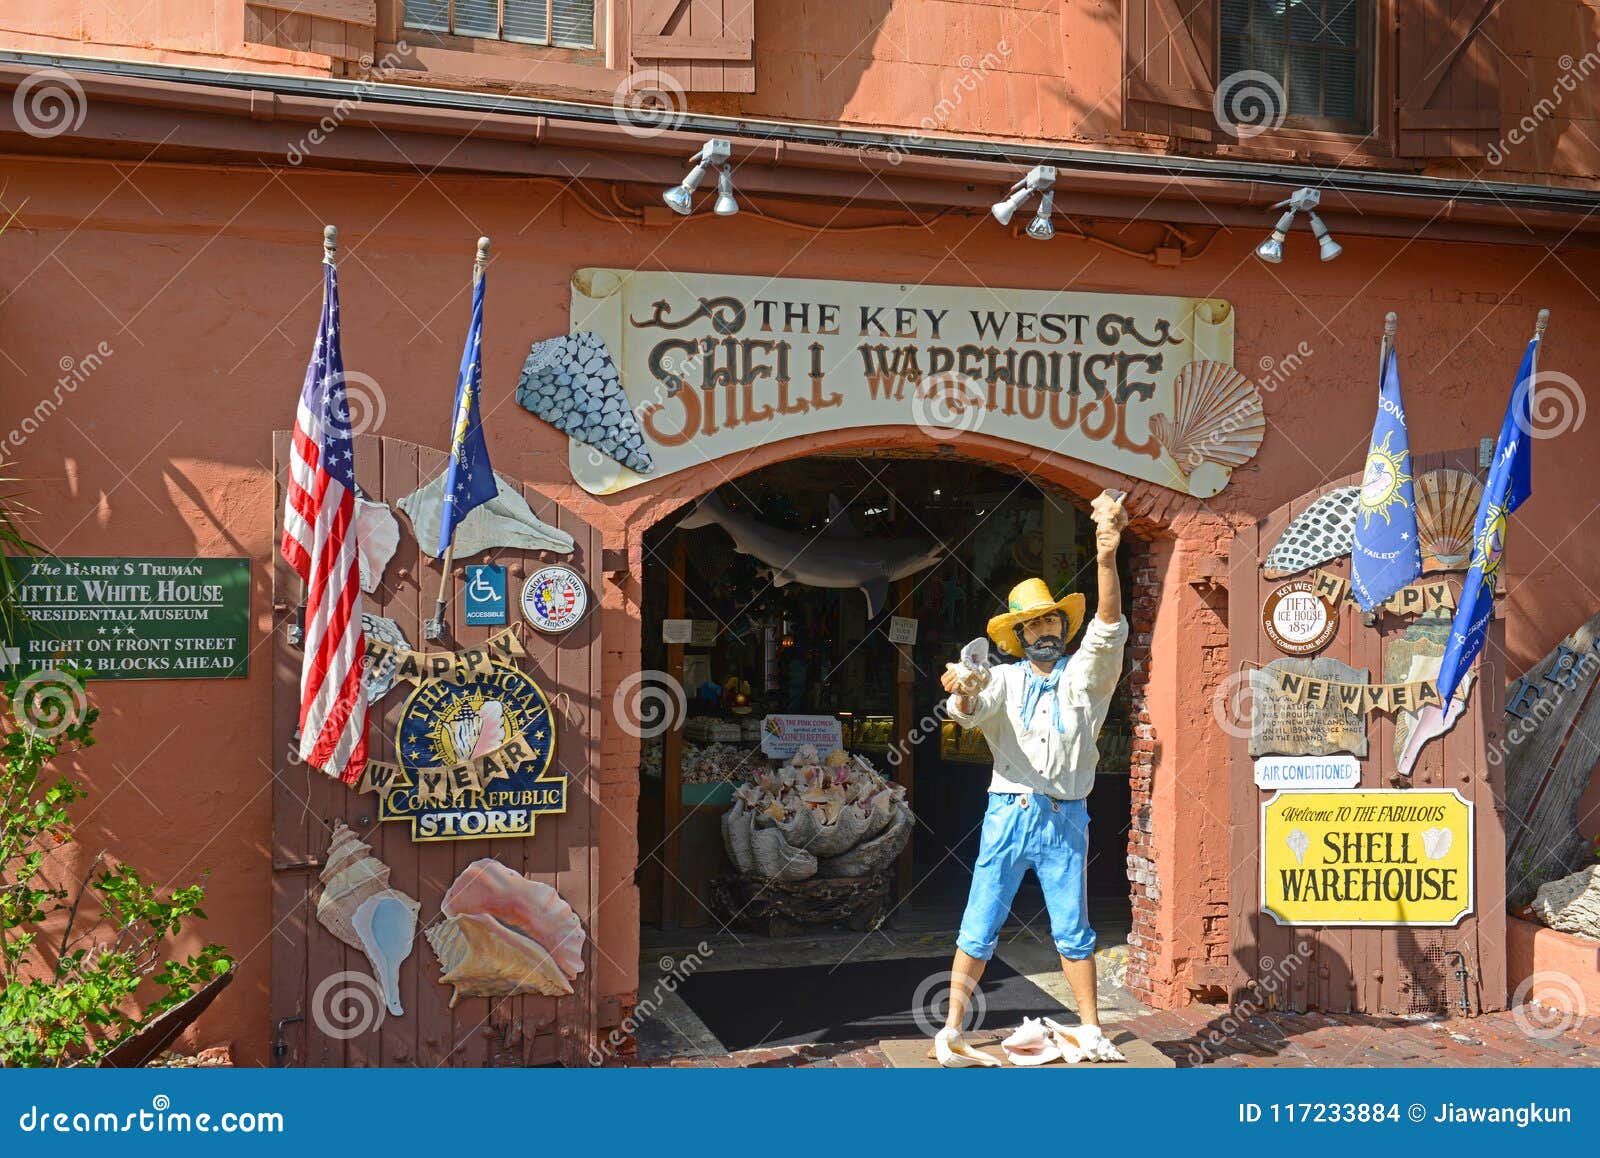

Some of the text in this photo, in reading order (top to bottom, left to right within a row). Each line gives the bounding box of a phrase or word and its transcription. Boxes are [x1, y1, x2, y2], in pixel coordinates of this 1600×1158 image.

[754, 300, 1090, 345] THE KEY WEST
[644, 336, 1164, 462] SHELL WAREHOUSE
[31, 562, 203, 576] The HARRY S TRUMAN
[83, 580, 152, 602] WHITE
[157, 580, 224, 602] HOUSE
[525, 573, 582, 602] Historic Tours
[1276, 583, 1312, 598] KEY WES
[1315, 574, 1445, 607] HPY
[140, 609, 208, 620] MUSEUM
[1278, 610, 1323, 621] ICE HOUSE
[1289, 621, 1310, 635] 1851
[29, 637, 236, 652] RIGHT ON FRONT STREET
[1265, 620, 1335, 651] OLDEST COMMERCIAL BUILDING
[28, 656, 235, 671] THEN 2 BLOCKS AHEAD
[365, 632, 513, 680] HAPPY
[408, 684, 449, 722] THE
[1281, 674, 1359, 704] NEW
[1367, 682, 1437, 706] YEA
[423, 741, 527, 795] YEAR
[1262, 764, 1353, 781] AIR CONDITIONED
[387, 786, 561, 815] CONCH REPUBLIC
[1281, 806, 1446, 822] Welcome TO THE FABULOUS
[419, 809, 528, 838] STORE
[1323, 832, 1418, 864] SHELL
[1280, 868, 1458, 902] WAREHOUSE
